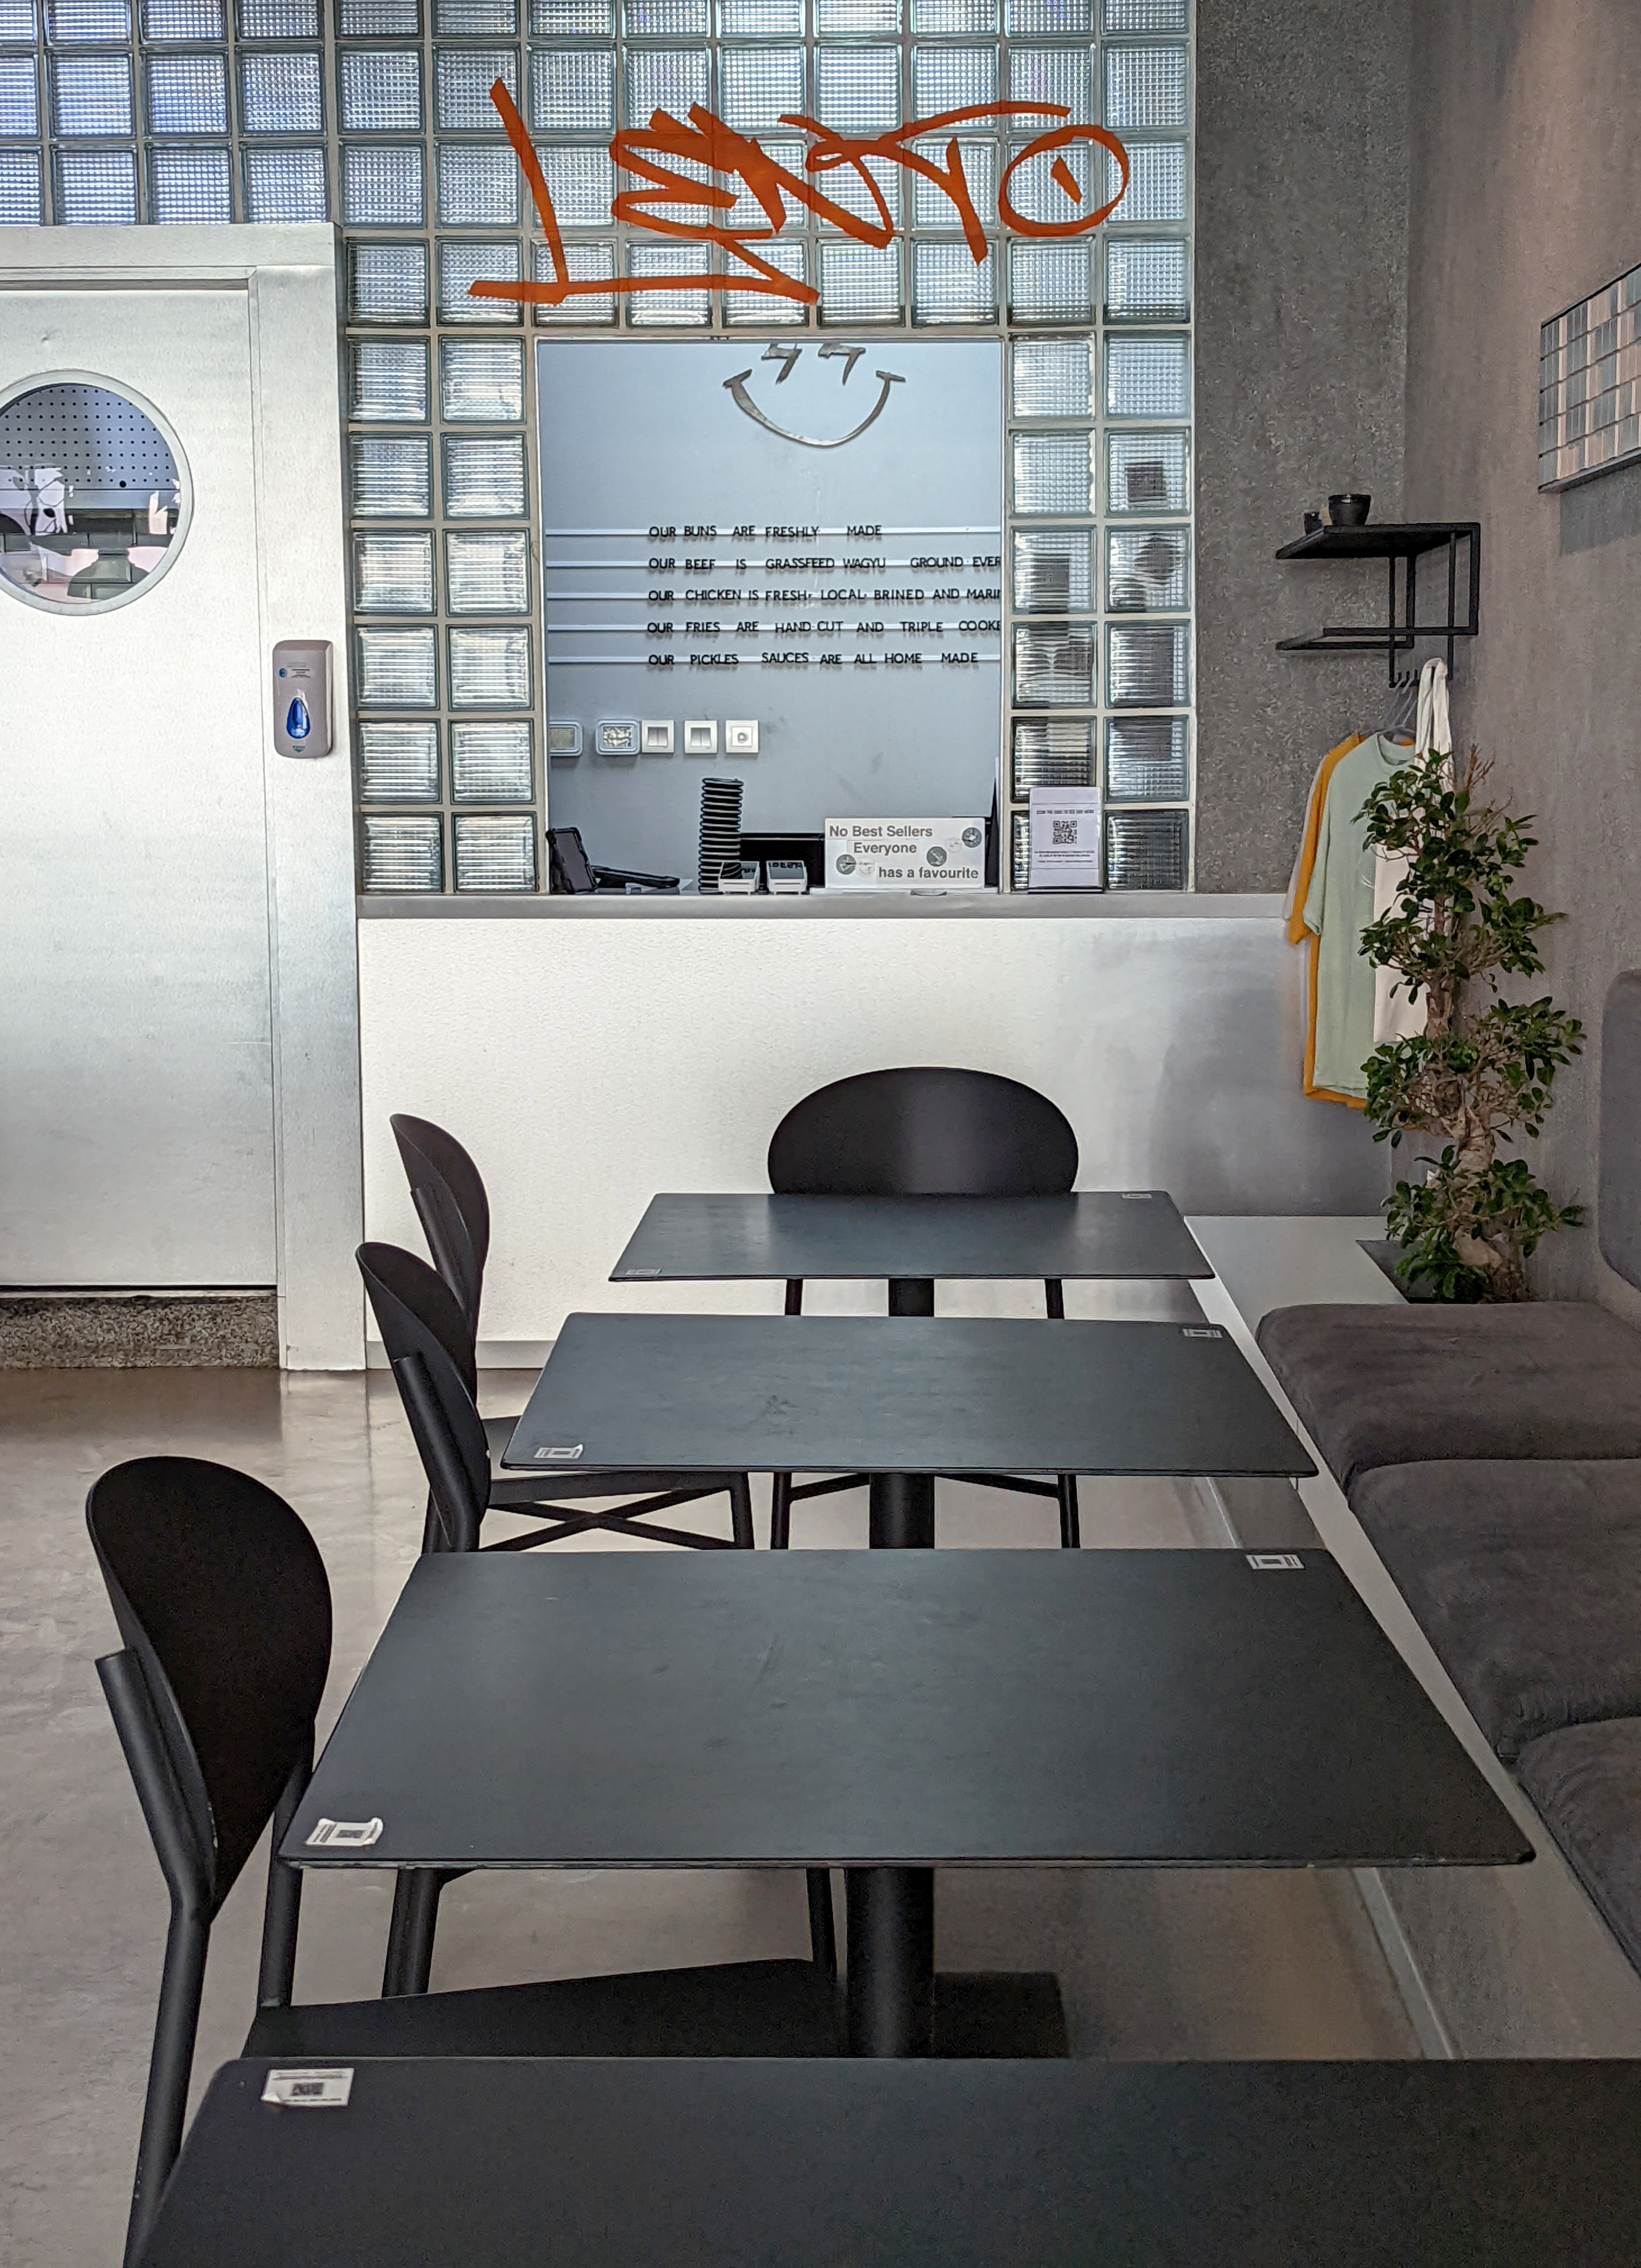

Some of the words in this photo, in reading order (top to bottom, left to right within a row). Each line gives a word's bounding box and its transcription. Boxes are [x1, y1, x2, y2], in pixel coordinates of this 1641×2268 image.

[649, 526, 676, 537] OUR
[684, 525, 717, 537] BUNS
[732, 525, 755, 536] ARE
[765, 526, 819, 537] FRESHLY
[847, 525, 882, 536] MADE
[649, 558, 675, 569] OUR
[685, 559, 715, 569] BEEF
[736, 559, 747, 569] IS
[843, 558, 886, 569] WAGYU
[910, 556, 963, 568] GROUND
[648, 590, 674, 601] OUR
[685, 589, 742, 600] CHICKEN
[748, 590, 759, 600] IS
[874, 589, 924, 600] BRINED
[932, 588, 960, 599] AND
[647, 622, 673, 633] OUR
[685, 621, 720, 632] FRIES
[735, 621, 759, 632] ARE
[774, 621, 811, 633] HAND
[817, 621, 844, 632] CUT
[856, 621, 884, 632] AND
[899, 621, 944, 632] TRIPLE
[648, 654, 674, 665] OUR
[689, 654, 739, 665] PICKLES
[761, 652, 809, 663] SAUCES
[819, 654, 843, 664] ARE
[853, 653, 877, 664] ALL
[884, 653, 923, 664] HOME
[941, 653, 978, 663] MADE
[829, 825, 848, 837] No
[852, 825, 883, 837] Best
[886, 825, 933, 837] Sellers
[853, 842, 917, 856] Everyone
[879, 867, 903, 878] has
[907, 869, 914, 878] a
[918, 867, 979, 879] favourite
